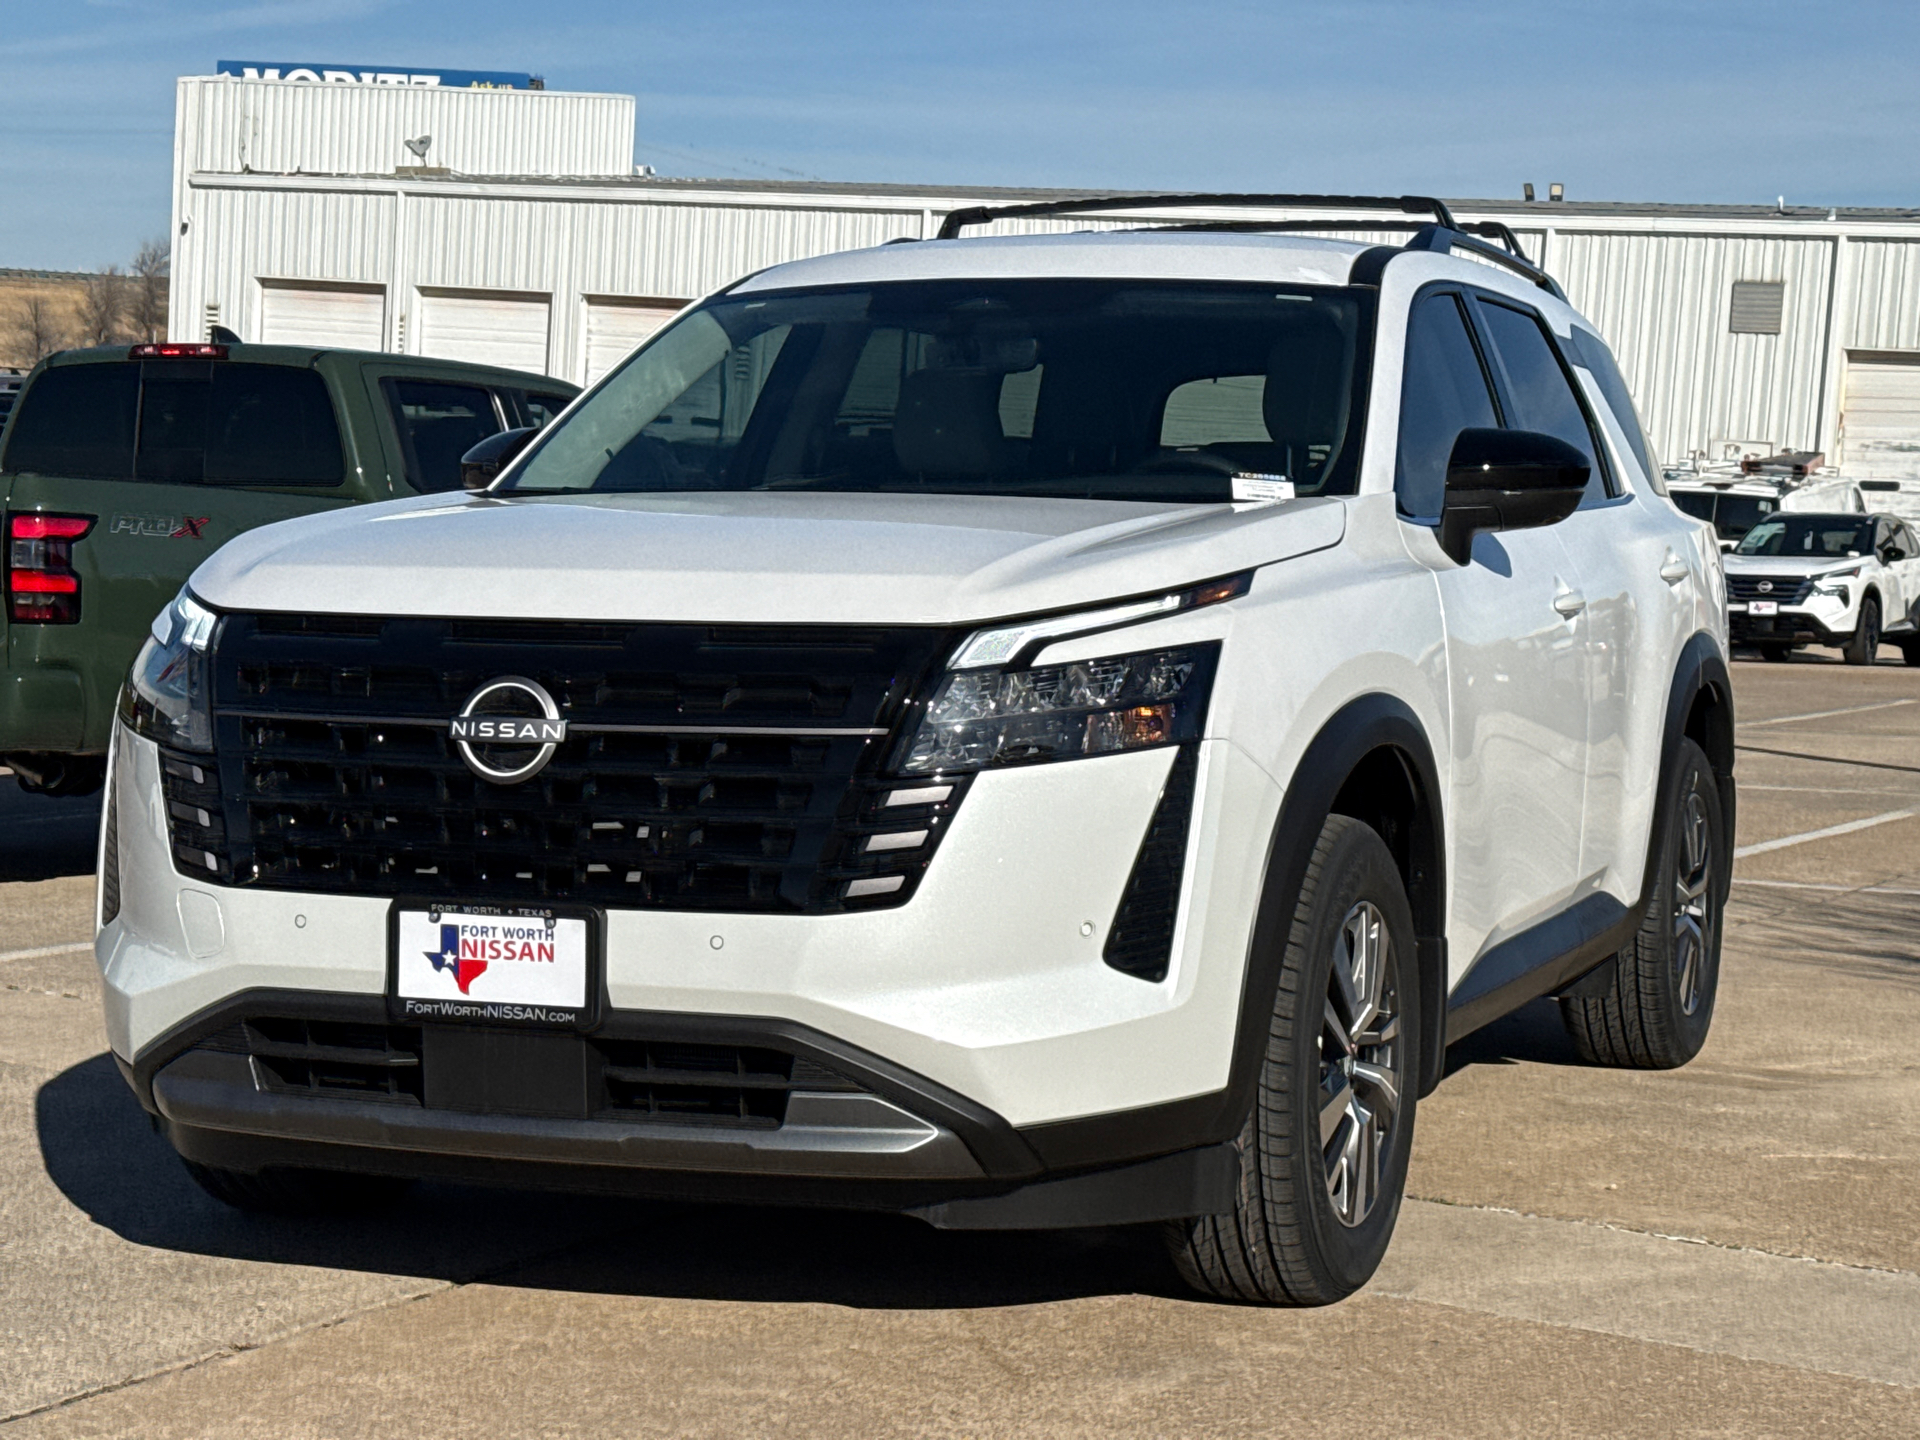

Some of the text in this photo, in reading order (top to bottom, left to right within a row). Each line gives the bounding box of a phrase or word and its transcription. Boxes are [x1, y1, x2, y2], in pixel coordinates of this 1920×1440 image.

[451, 720, 562, 739] NISSAN
[431, 903, 552, 918] FORT WORTH TEXAS
[461, 924, 554, 942] FORT WORTH
[461, 938, 555, 963] NISSAN
